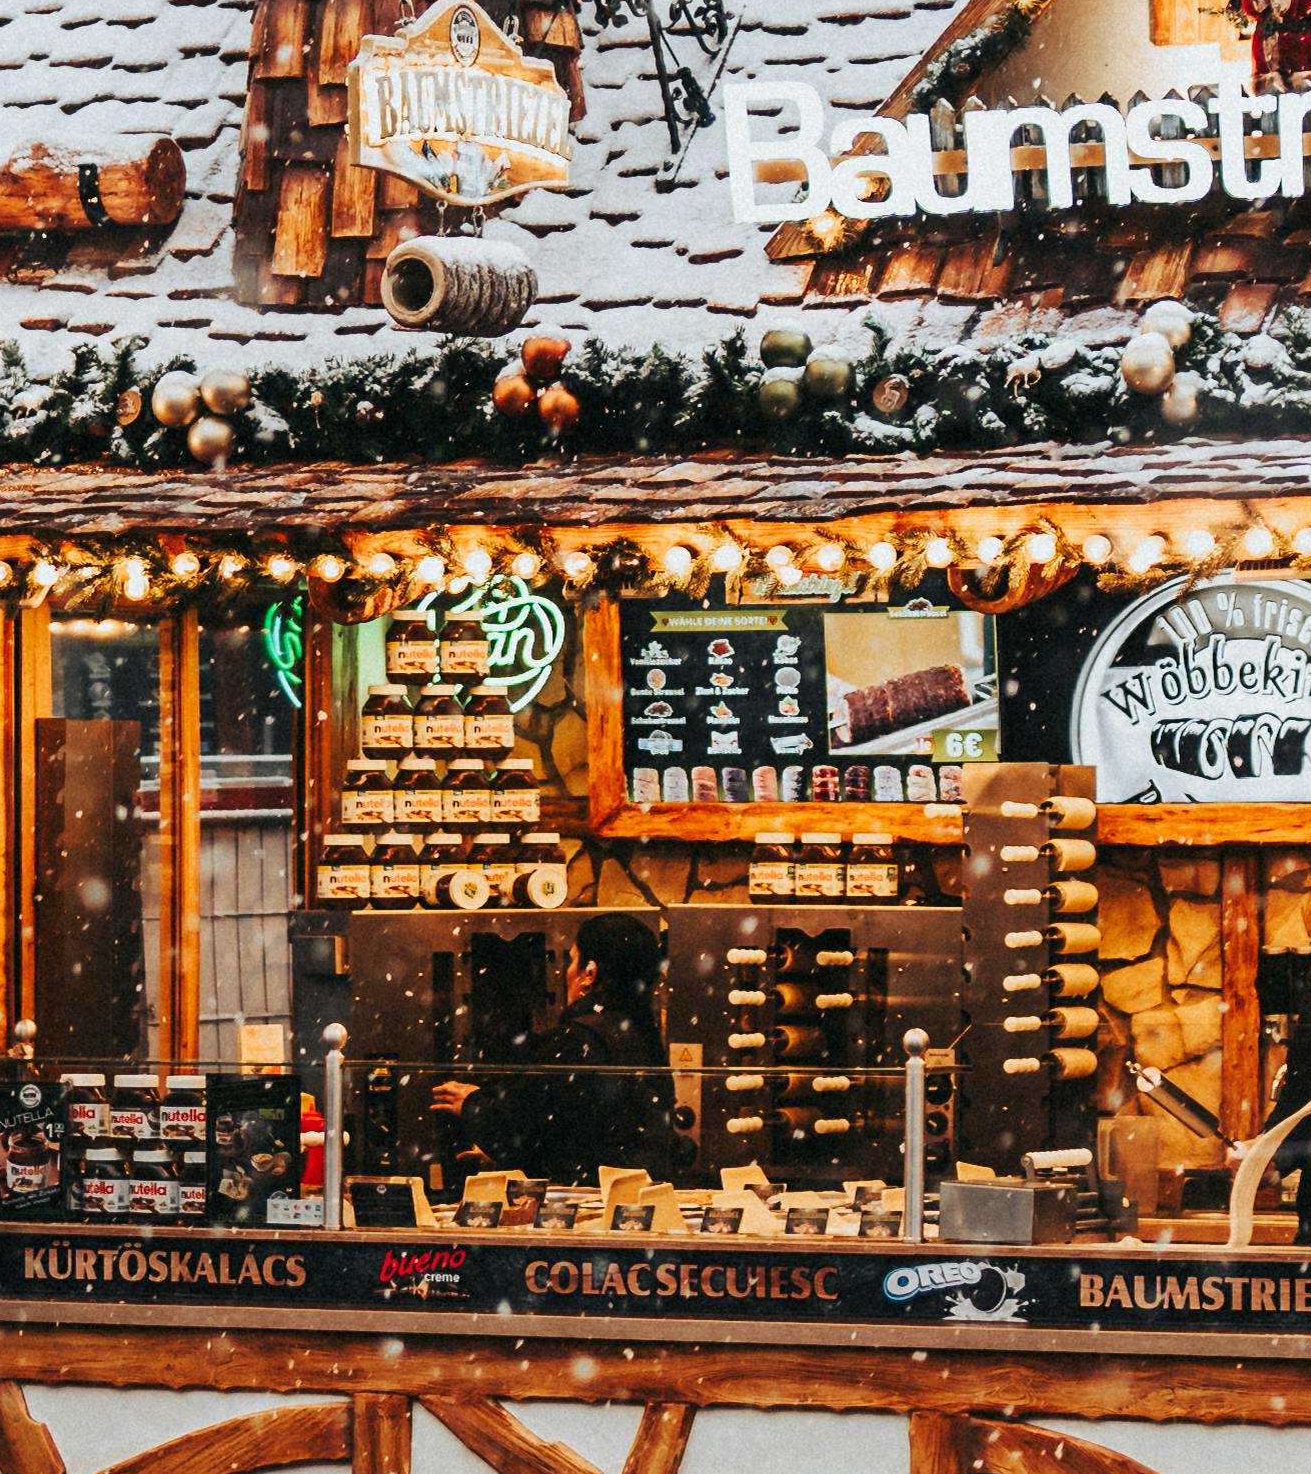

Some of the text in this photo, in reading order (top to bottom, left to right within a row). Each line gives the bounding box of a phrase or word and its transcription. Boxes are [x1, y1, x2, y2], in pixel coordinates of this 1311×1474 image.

[945, 731, 984, 758] 6€
[112, 1115, 143, 1124] nutella
[162, 1109, 206, 1121] nutella
[181, 1186, 206, 1199] nutel
[23, 1240, 307, 1288] KÜRTÖSKALÁCS
[378, 1249, 467, 1282] bueno
[424, 1272, 461, 1283] creme
[525, 1260, 839, 1301] COLAC SECUIESC
[885, 1260, 983, 1301] OREO
